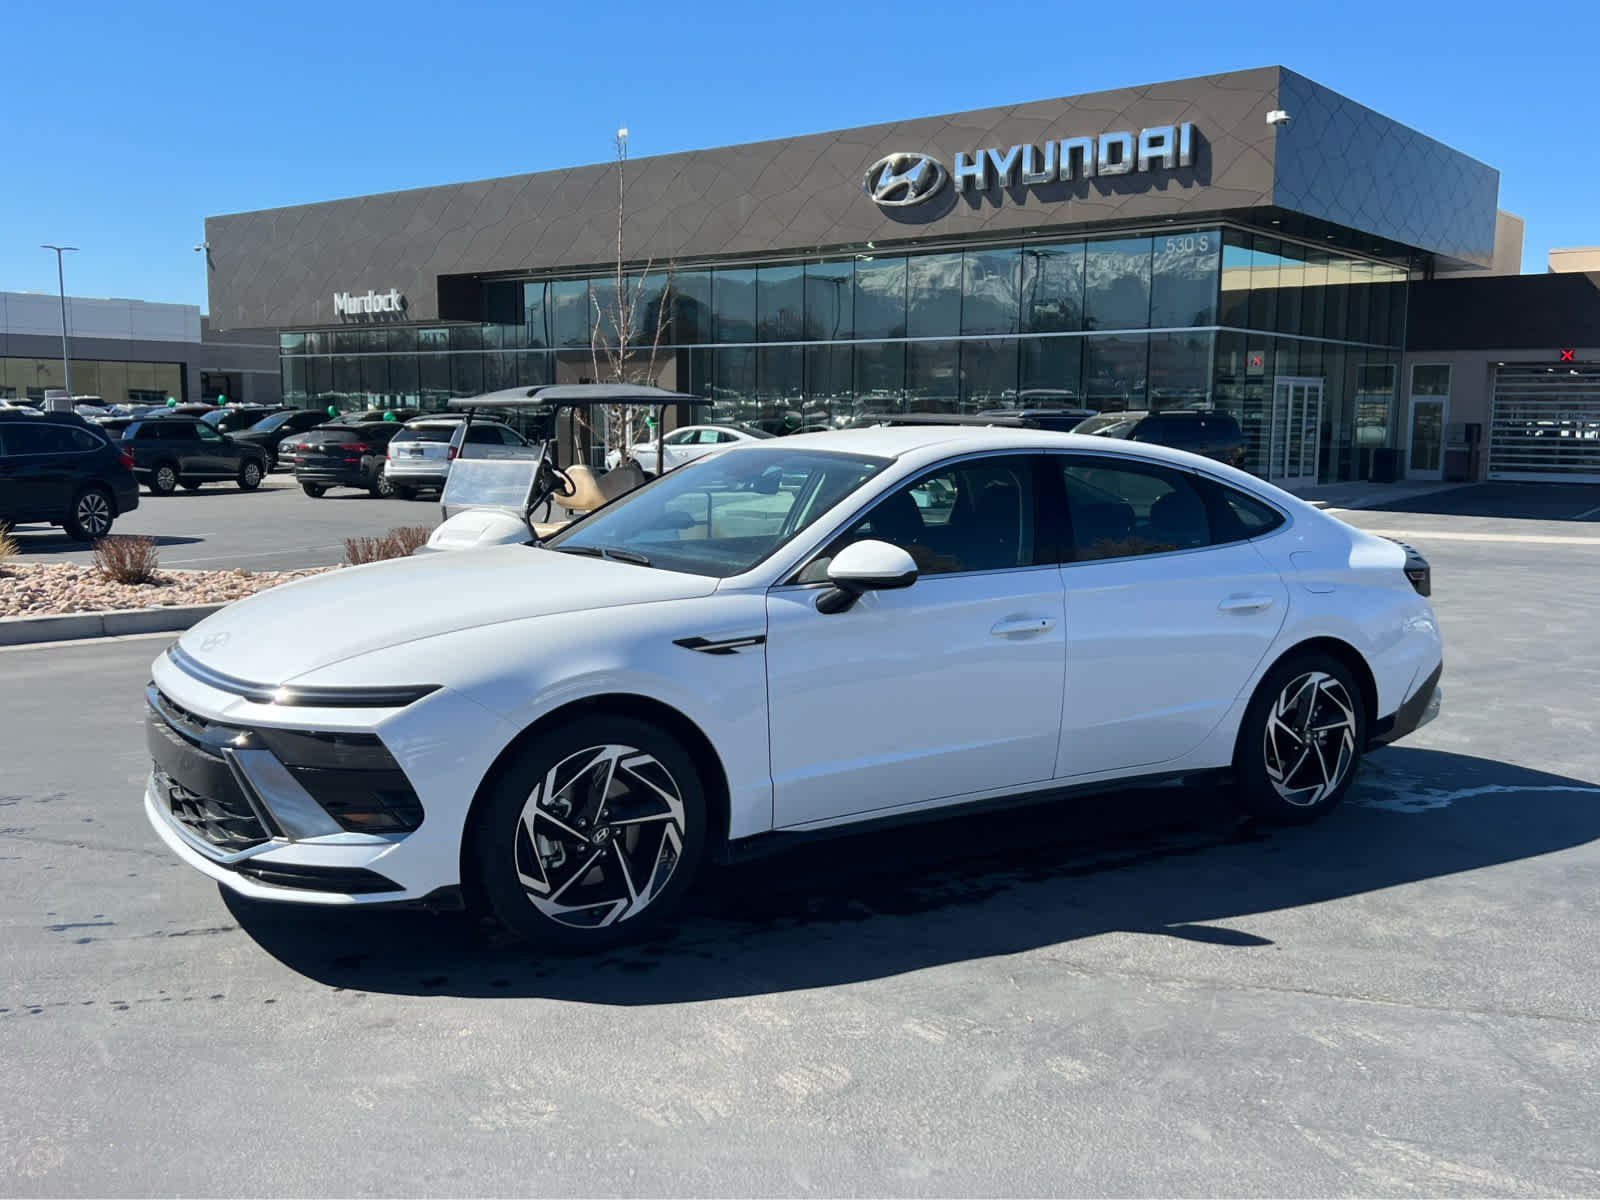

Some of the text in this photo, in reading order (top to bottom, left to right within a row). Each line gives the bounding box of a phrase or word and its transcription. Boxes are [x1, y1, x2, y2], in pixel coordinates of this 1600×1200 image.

[953, 121, 1196, 193] HYUNDAI
[1166, 235, 1209, 253] 530 S
[333, 287, 401, 316] Murdock
